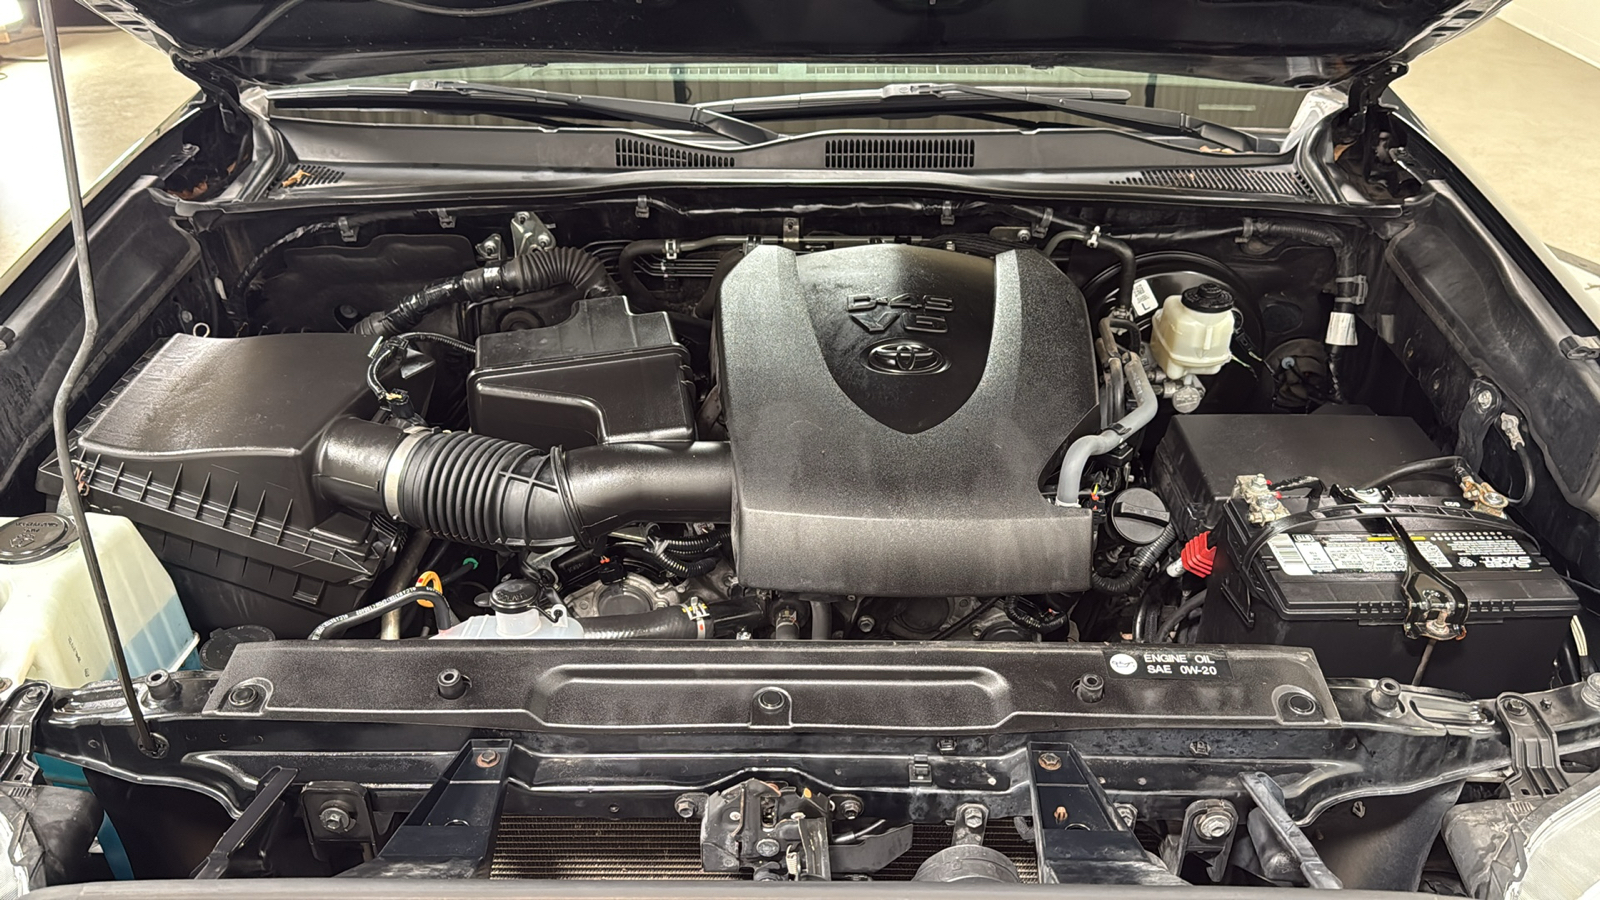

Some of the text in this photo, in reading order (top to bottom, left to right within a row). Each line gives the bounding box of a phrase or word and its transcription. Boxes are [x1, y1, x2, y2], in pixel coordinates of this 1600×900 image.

[850, 312, 948, 333] V6
[1143, 653, 1215, 664] ENGINE OIL
[1146, 664, 1218, 675] SAE 0W-20
